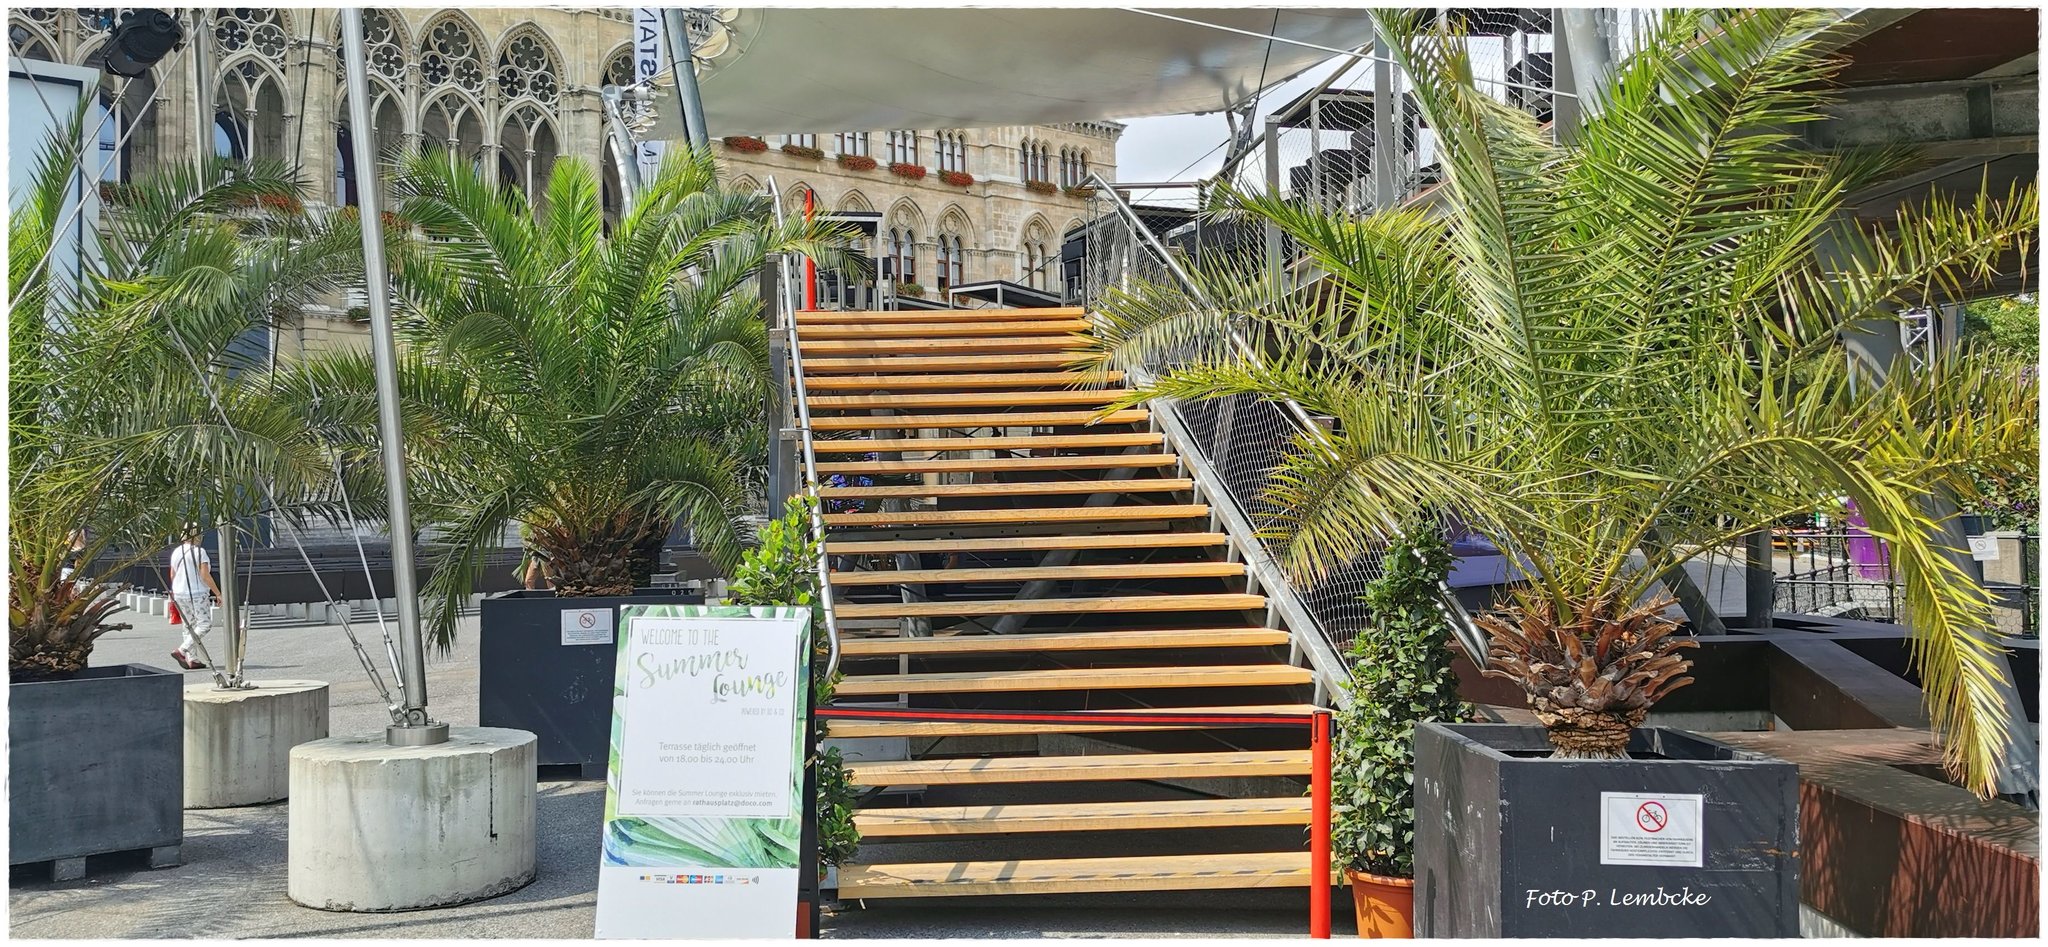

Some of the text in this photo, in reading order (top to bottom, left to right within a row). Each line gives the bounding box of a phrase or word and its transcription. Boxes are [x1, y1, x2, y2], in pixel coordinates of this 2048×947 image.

[641, 629, 719, 646] WELCOME TO THE
[637, 648, 748, 689] Summer
[711, 670, 787, 704] Lounge
[659, 742, 757, 754] Terrasse täglich geöffnet
[676, 755, 698, 763] 18.00
[700, 755, 713, 763] bis
[714, 756, 738, 765] 24.00
[739, 755, 754, 763] Uhr
[705, 790, 727, 798] Lounge
[692, 799, 773, 807] rathausplatz@doco.com
